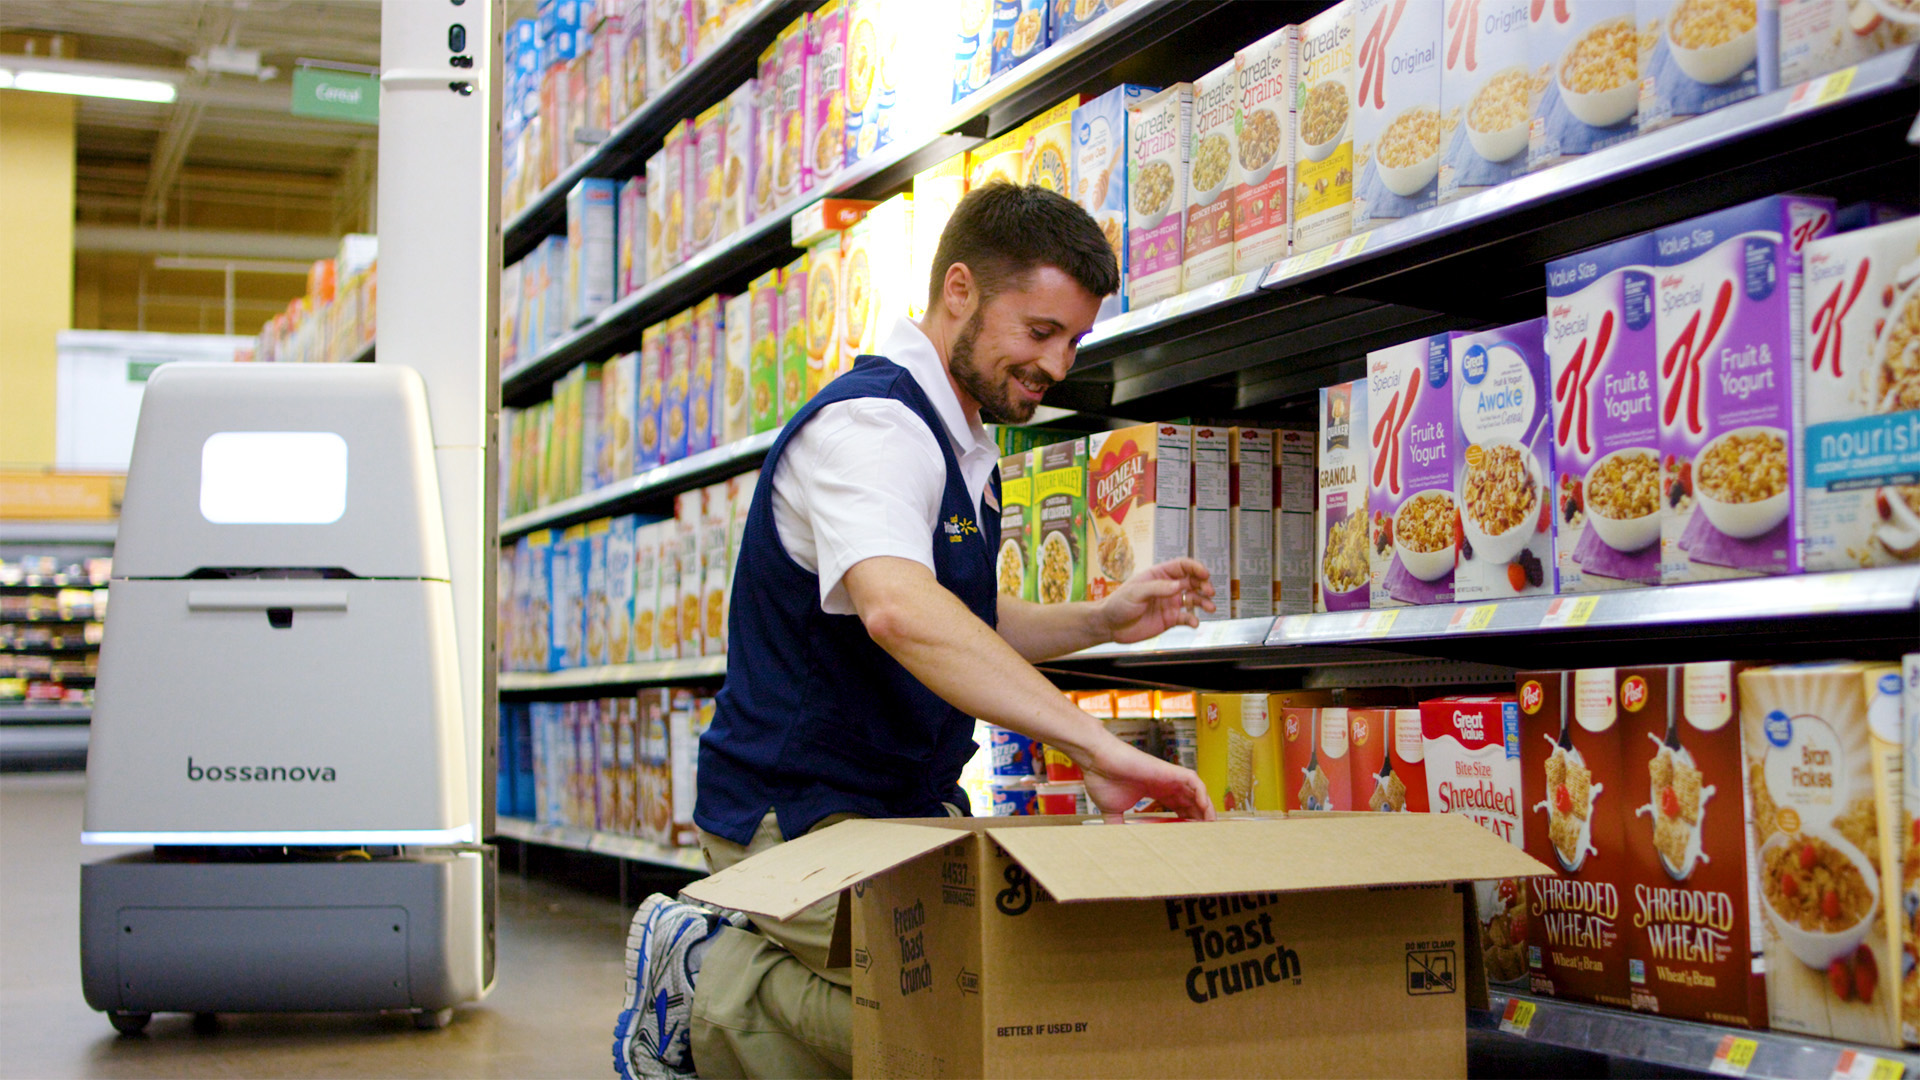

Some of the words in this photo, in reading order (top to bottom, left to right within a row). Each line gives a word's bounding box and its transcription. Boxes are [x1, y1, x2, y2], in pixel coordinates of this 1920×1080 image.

[1485, 6, 1528, 34] Origina
[1303, 21, 1339, 76] great
[1358, 0, 1407, 110] K
[1391, 41, 1435, 75] Original
[1240, 50, 1271, 103] great
[1306, 44, 1352, 92] grains
[315, 82, 363, 104] Cereal
[1196, 79, 1226, 128] great
[1243, 74, 1283, 119] grains
[1134, 106, 1168, 154] great
[1199, 100, 1235, 143] grains
[1138, 128, 1176, 169] grains
[1658, 236, 1690, 256] Value
[1692, 229, 1714, 248] Size
[1549, 268, 1577, 287] Value
[1578, 261, 1597, 280] Size
[1662, 282, 1705, 316] Special
[1554, 312, 1589, 343] Special
[1811, 256, 1870, 378] K
[1663, 279, 1732, 434] K
[1721, 345, 1758, 372] Fruit
[1759, 343, 1773, 365] &
[1372, 369, 1401, 396] Special
[1556, 310, 1614, 454] K
[1605, 371, 1636, 396] Fruit
[1637, 370, 1650, 390] &
[1719, 368, 1774, 399] Yogurt
[1477, 386, 1523, 414] Awake
[1603, 395, 1652, 422] Yogurt
[1372, 367, 1421, 495] K
[1410, 421, 1435, 444] Fruit
[1436, 421, 1445, 440] &
[1821, 415, 1920, 460] nourish
[1409, 441, 1446, 467] Yogurt
[1097, 456, 1144, 500] OATMEAL
[1320, 464, 1357, 489] GRANOLA
[1106, 477, 1135, 512] CRISP
[1523, 685, 1539, 707] Post
[1624, 682, 1644, 705] Post
[1286, 719, 1298, 737] Post
[1353, 722, 1367, 739] Post
[1453, 710, 1484, 729] Great
[1460, 728, 1485, 740] Value
[187, 756, 337, 782] bossanova
[1455, 760, 1472, 776] Bite
[1473, 761, 1492, 777] Size
[1439, 779, 1517, 817] Shredded
[1532, 877, 1618, 919] SHREDDED
[1633, 883, 1733, 931] SHREDDED
[893, 898, 925, 937] French
[1544, 912, 1614, 949] WHEAT
[899, 929, 925, 965] Toast
[1184, 912, 1275, 963] Toast
[1405, 942, 1415, 950] DO
[1416, 941, 1430, 949] NOT
[1431, 940, 1456, 949] CLAMP
[1647, 923, 1728, 963] WHEAT
[900, 958, 932, 996] Crunch
[1186, 945, 1301, 1003] Crunch
[1583, 956, 1604, 972] Bran
[1692, 970, 1716, 988] Bran
[997, 1025, 1033, 1037] BETTER
[1036, 1024, 1045, 1035] IF
[1047, 1023, 1073, 1034] USED
[1075, 1022, 1088, 1032] BY
